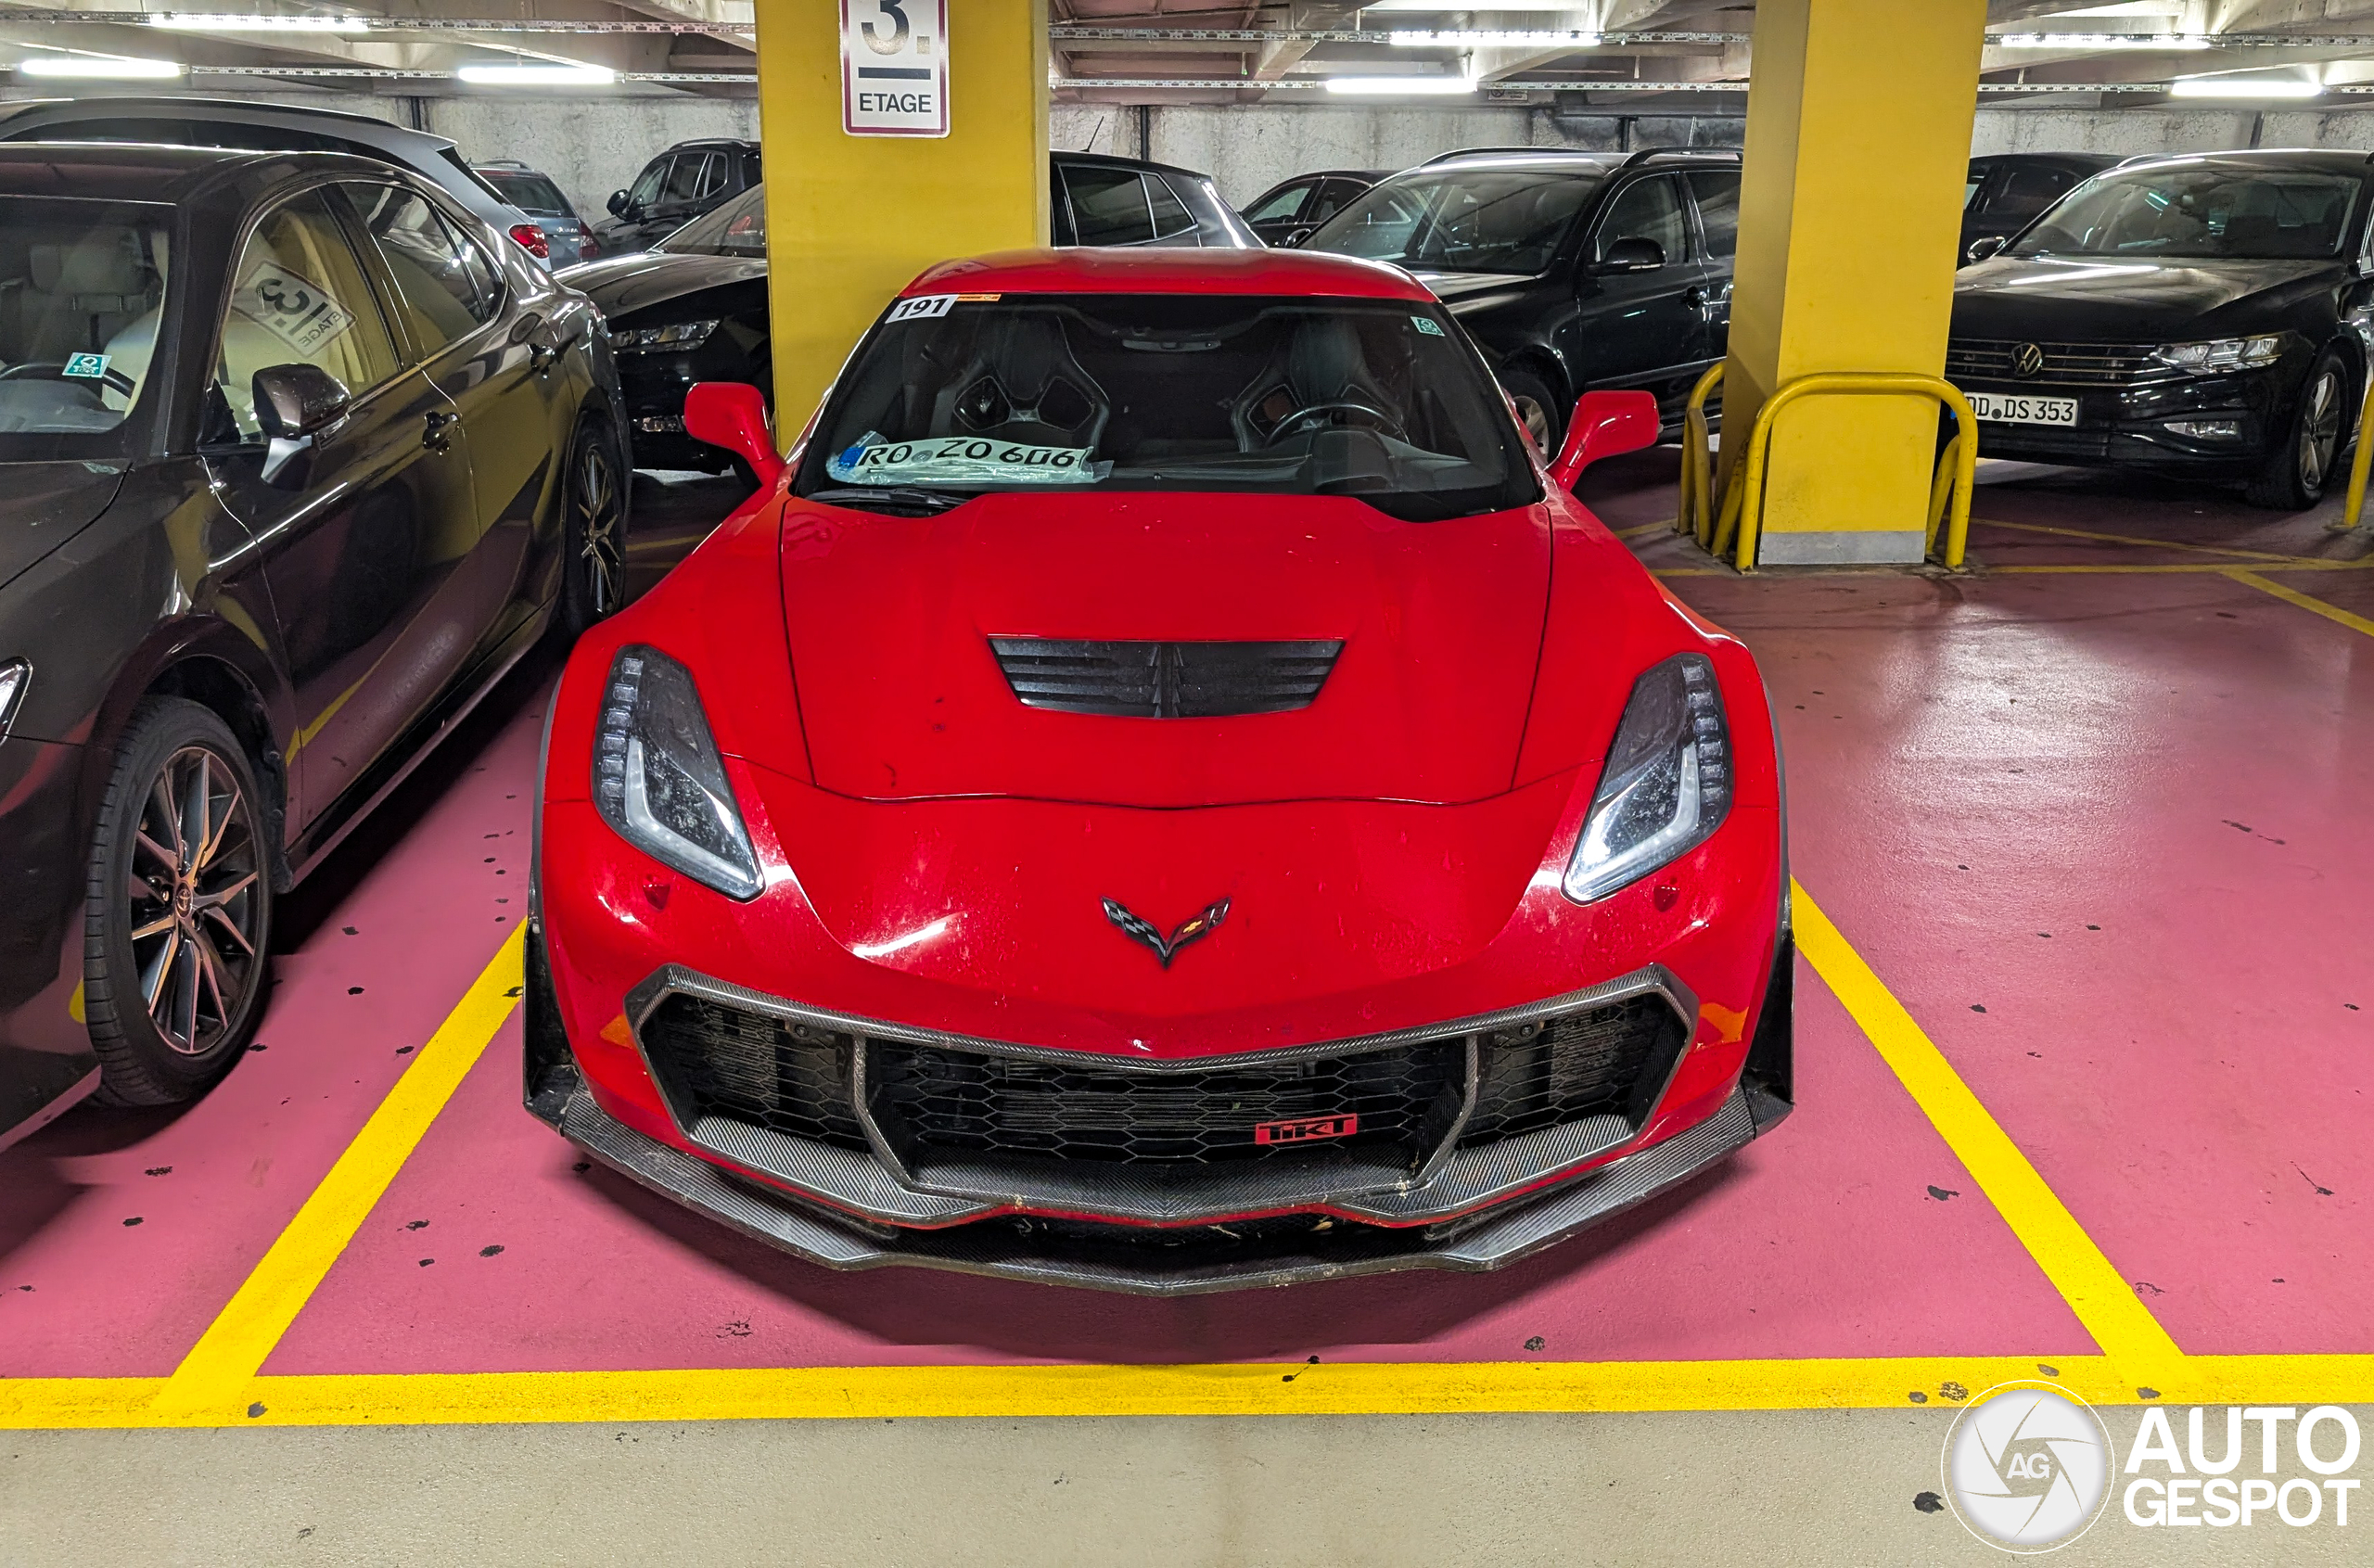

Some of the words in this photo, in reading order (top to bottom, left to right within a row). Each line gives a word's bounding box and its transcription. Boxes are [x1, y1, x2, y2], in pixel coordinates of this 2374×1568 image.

[859, 93, 932, 113] ETAGE
[897, 297, 949, 319] 191
[2003, 399, 2030, 420] DS
[2034, 400, 2074, 422] 353
[857, 444, 913, 466] RO
[935, 440, 993, 461] ZO
[999, 446, 1076, 467] 606
